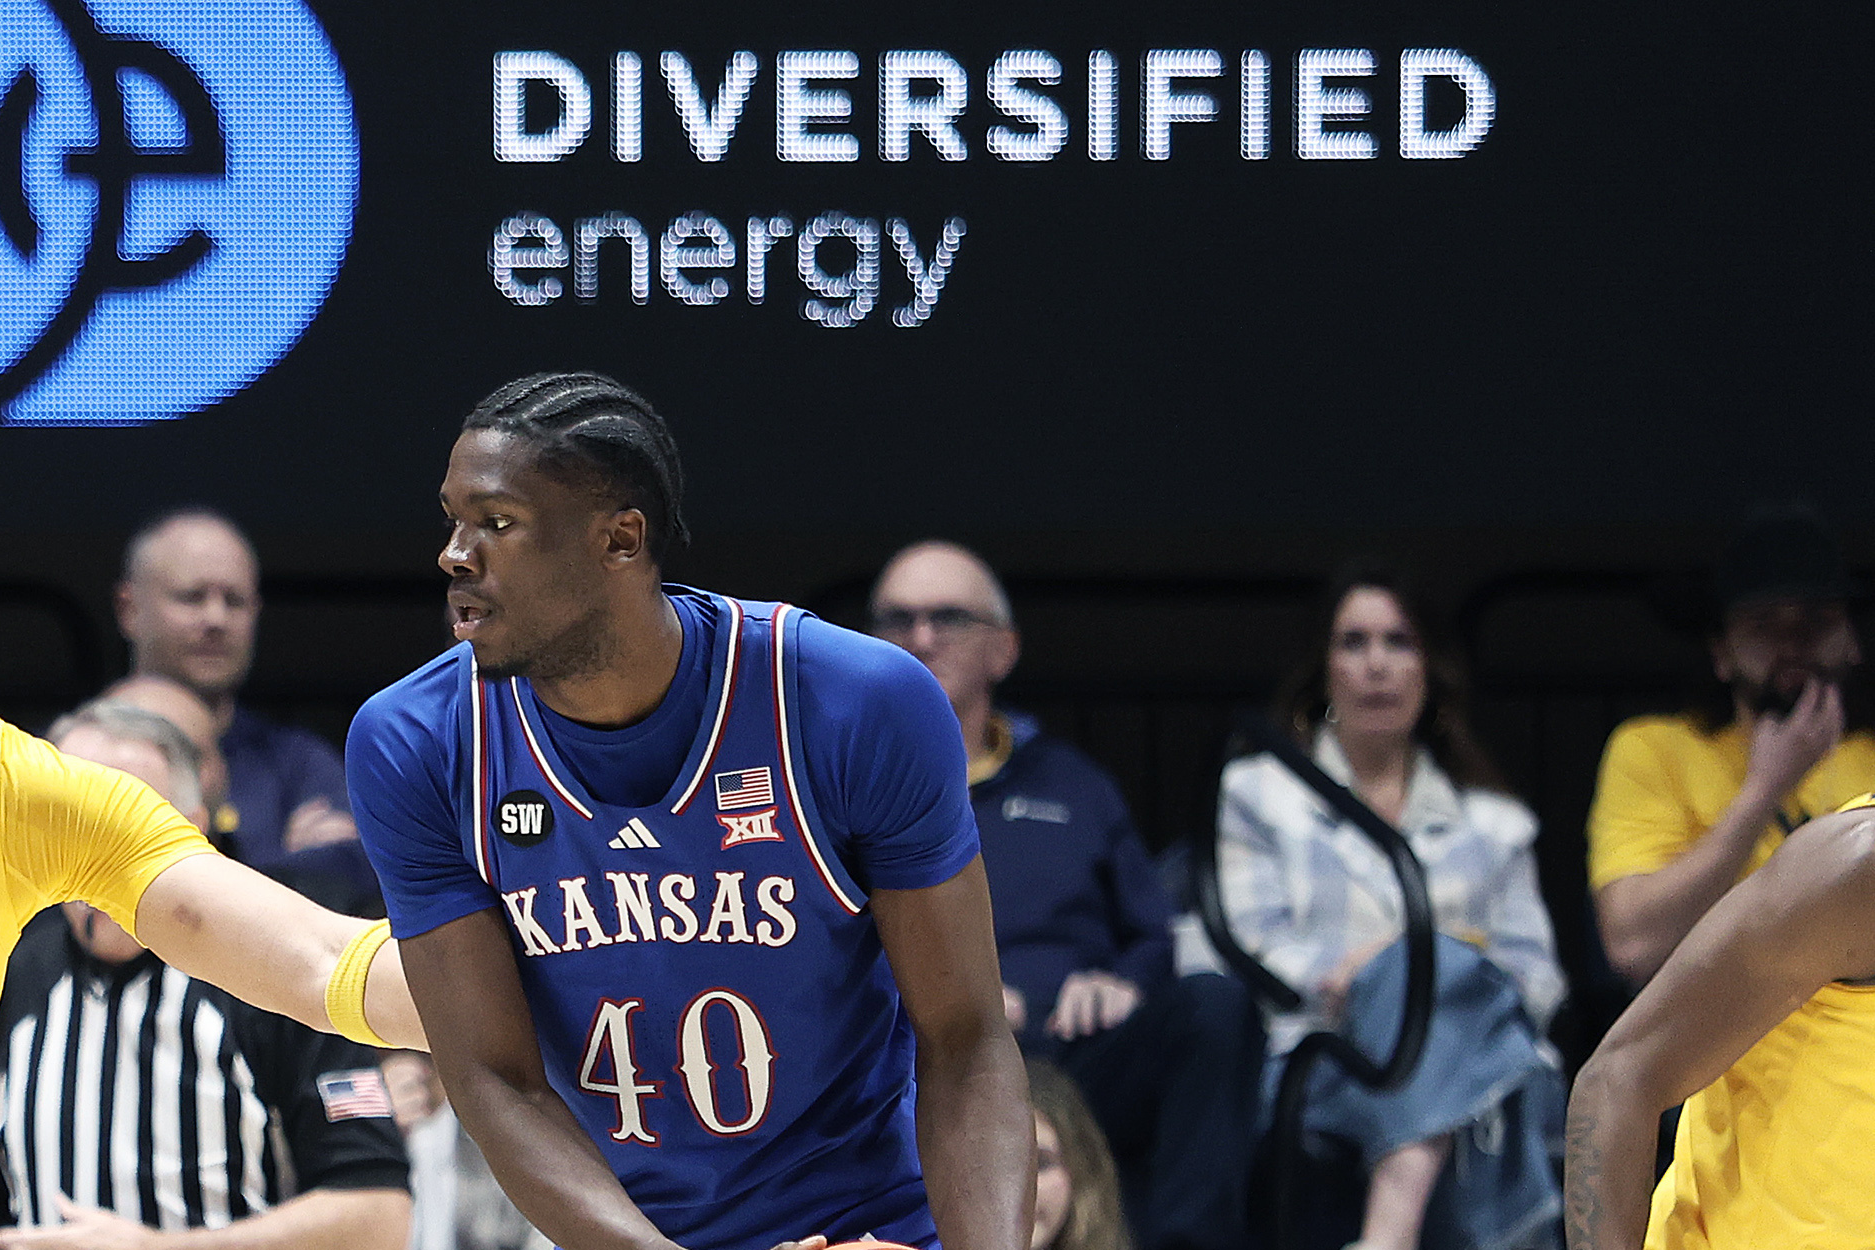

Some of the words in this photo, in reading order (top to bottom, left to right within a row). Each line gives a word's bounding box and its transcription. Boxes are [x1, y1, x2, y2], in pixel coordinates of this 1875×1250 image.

[491, 49, 1496, 163] DIVERSIFIED
[488, 210, 968, 328] energy
[501, 803, 544, 835] SW
[718, 808, 781, 848] XII
[501, 871, 797, 957] KANSAS
[578, 987, 778, 1146] 40
